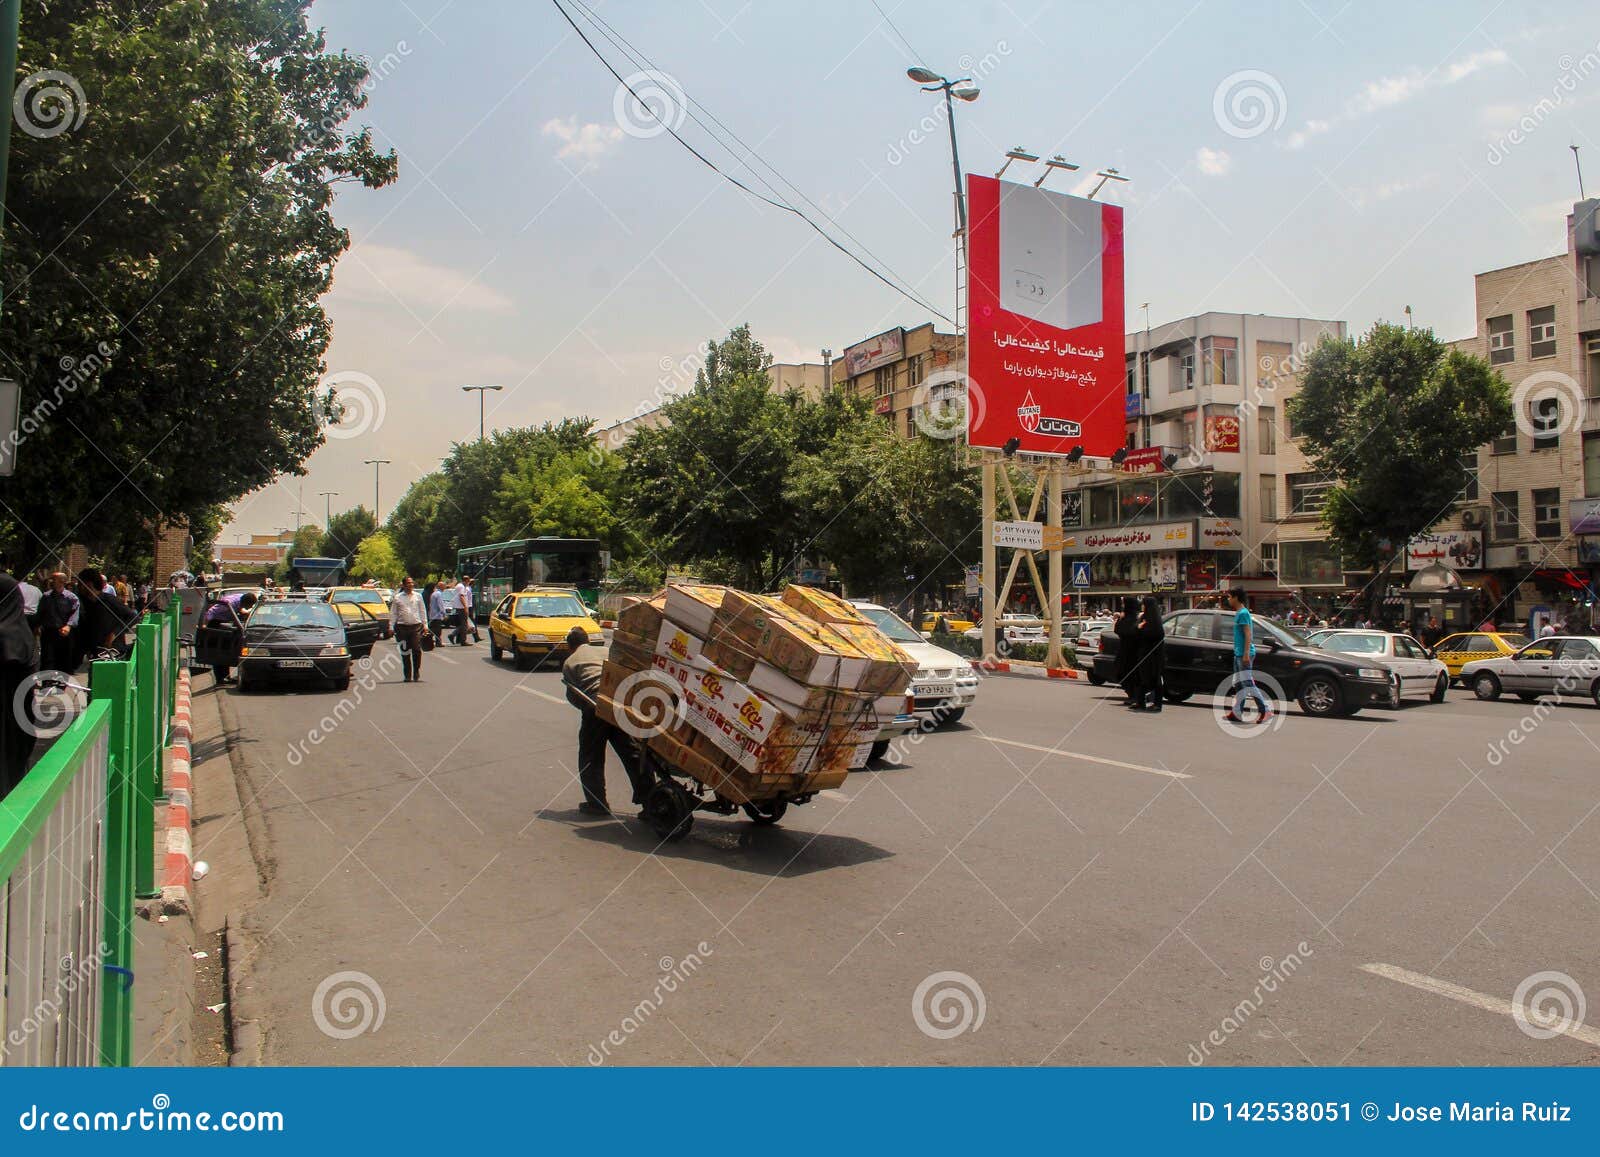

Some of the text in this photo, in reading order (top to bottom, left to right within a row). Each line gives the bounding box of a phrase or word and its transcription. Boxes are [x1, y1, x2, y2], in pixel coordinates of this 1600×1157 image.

[994, 331, 1104, 361] قیمت عالی! کیفیت عالی!
[1004, 360, 1097, 386] پکیج شوفاژ دیواری پارما
[1018, 405, 1041, 416] BUTANE
[1040, 419, 1079, 435] بوتان
